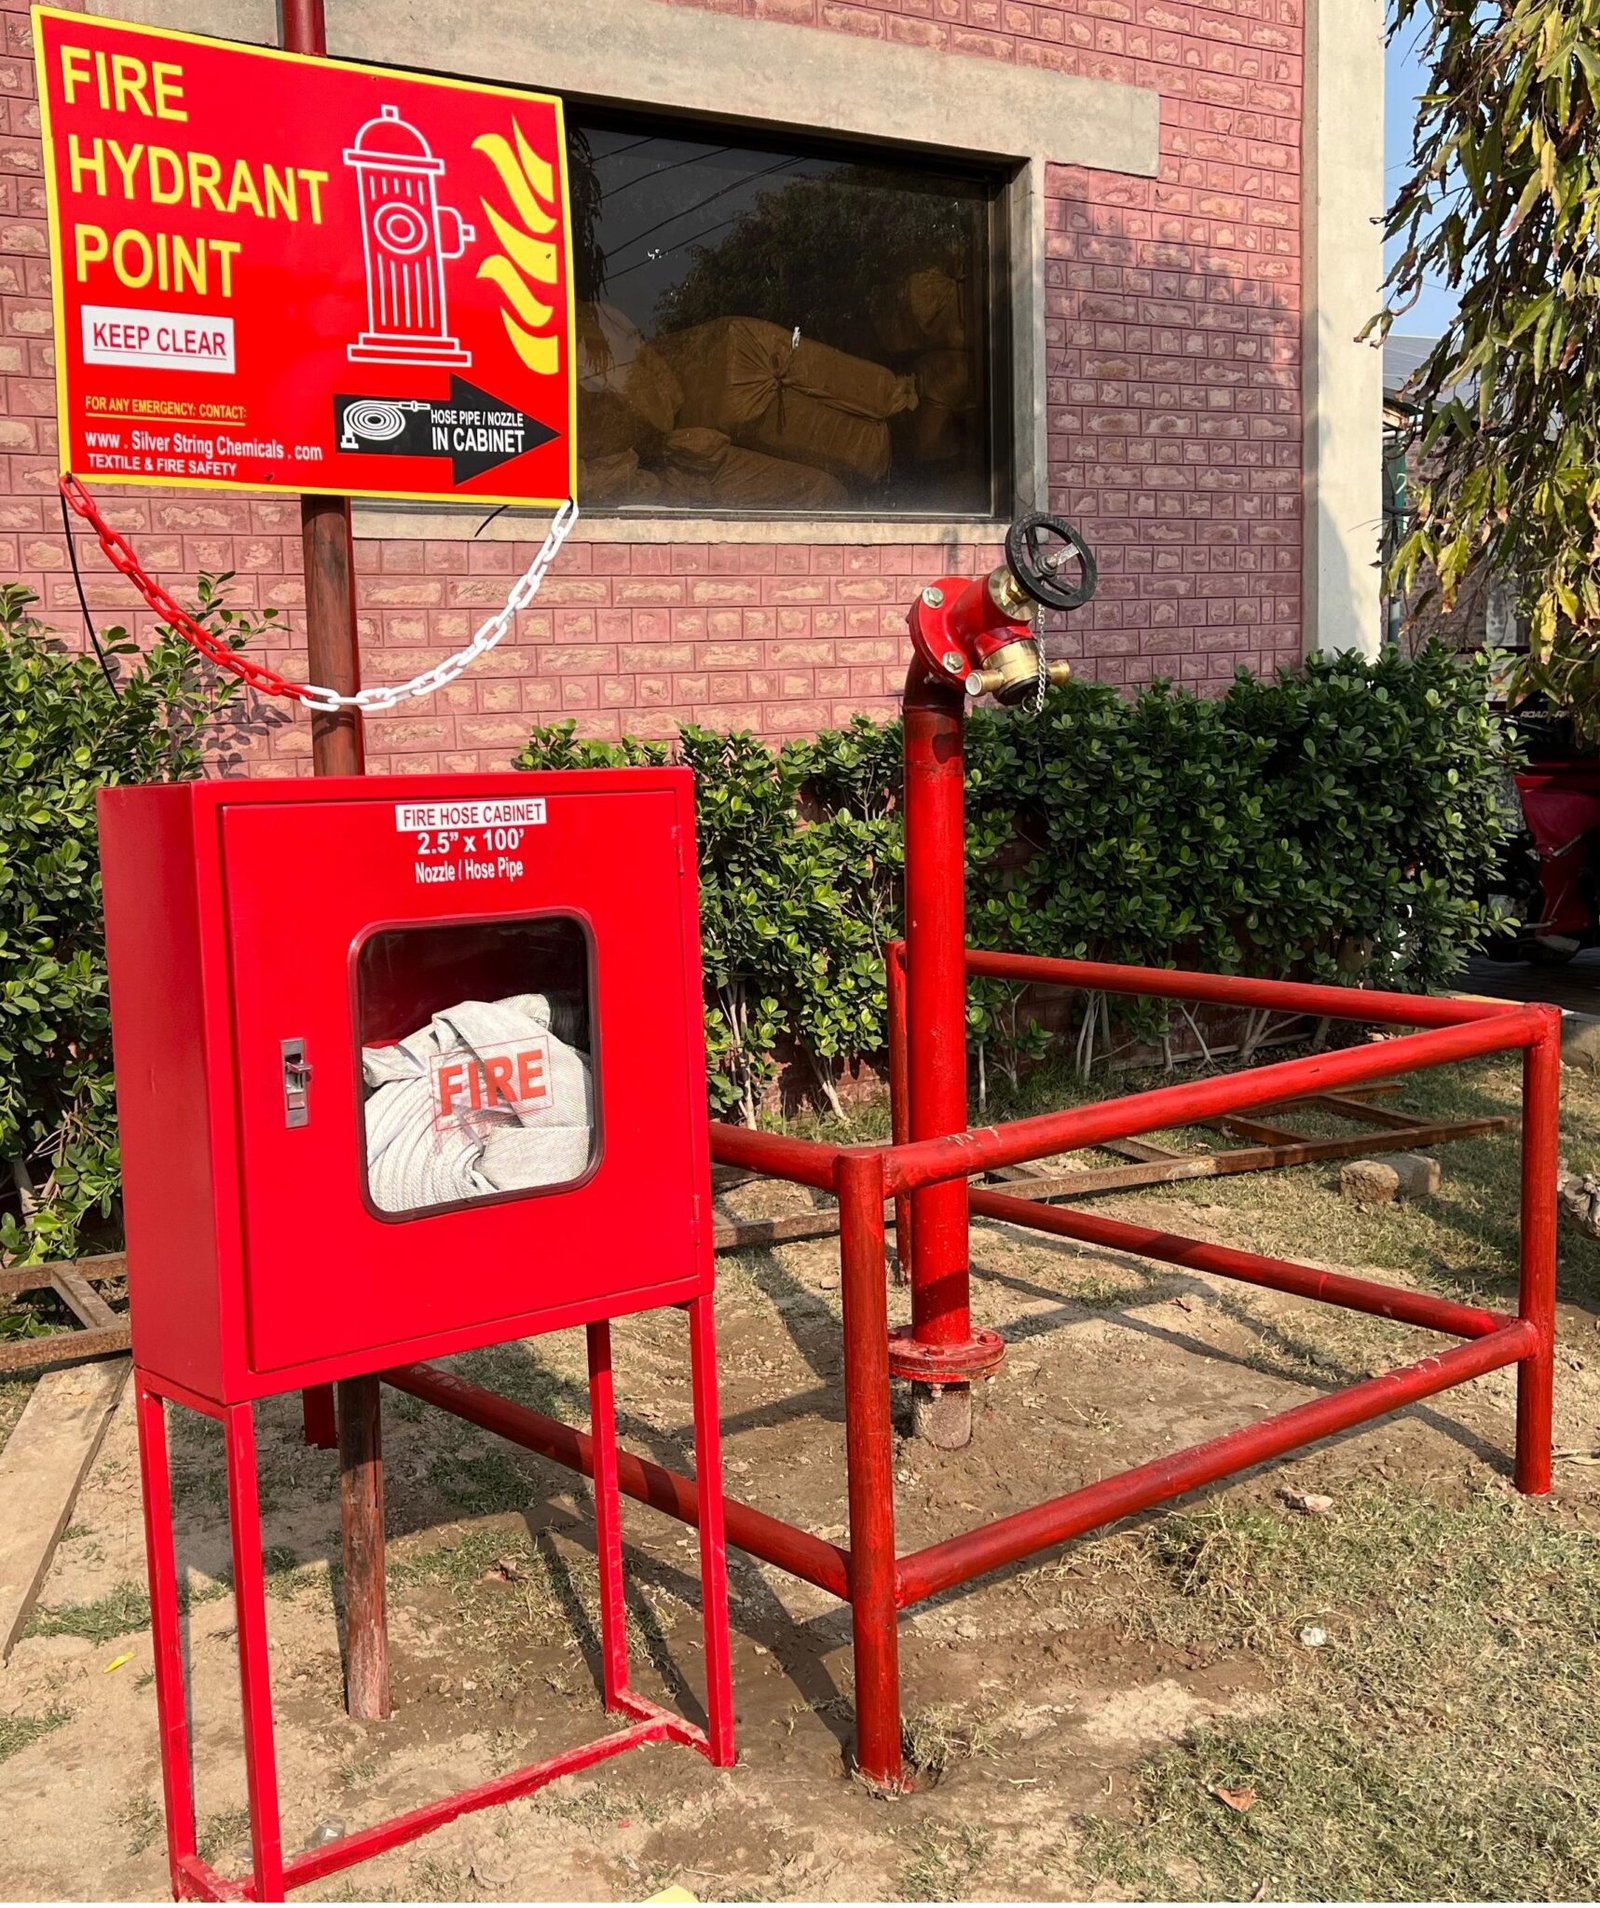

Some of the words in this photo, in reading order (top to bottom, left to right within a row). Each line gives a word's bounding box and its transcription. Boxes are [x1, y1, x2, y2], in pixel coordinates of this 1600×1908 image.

[60, 45, 188, 122] FIRE
[67, 134, 329, 224] HYDRANT
[74, 224, 241, 298] POINT
[93, 322, 150, 350] KEEP
[156, 327, 227, 356] CLEAR
[85, 396, 107, 411] FOR
[108, 398, 129, 413] ANY
[132, 399, 196, 417] EMERGENCY:
[199, 404, 246, 420] CONTACT:
[431, 409, 458, 424] HOSE
[459, 411, 481, 426] PIPE
[482, 411, 486, 425] /
[487, 412, 524, 427] NOZZLE
[85, 431, 120, 449] www
[131, 430, 170, 452] Silver
[173, 432, 213, 459] String
[216, 436, 284, 460] Chemicals
[294, 444, 323, 461] com
[432, 427, 449, 451] IN
[453, 429, 525, 453] CABINET
[88, 453, 140, 470] TEXTILE
[144, 457, 154, 471] &
[156, 458, 185, 473] FIRE
[188, 460, 237, 477] SAFETY
[403, 808, 436, 828] FIRE
[440, 806, 480, 826] HOSE
[483, 803, 542, 823] CABINET
[463, 836, 477, 853] x
[415, 861, 455, 884] Nozzle
[464, 858, 495, 880] Hose
[497, 856, 524, 882] Pipe
[438, 1049, 547, 1117] FIRE
